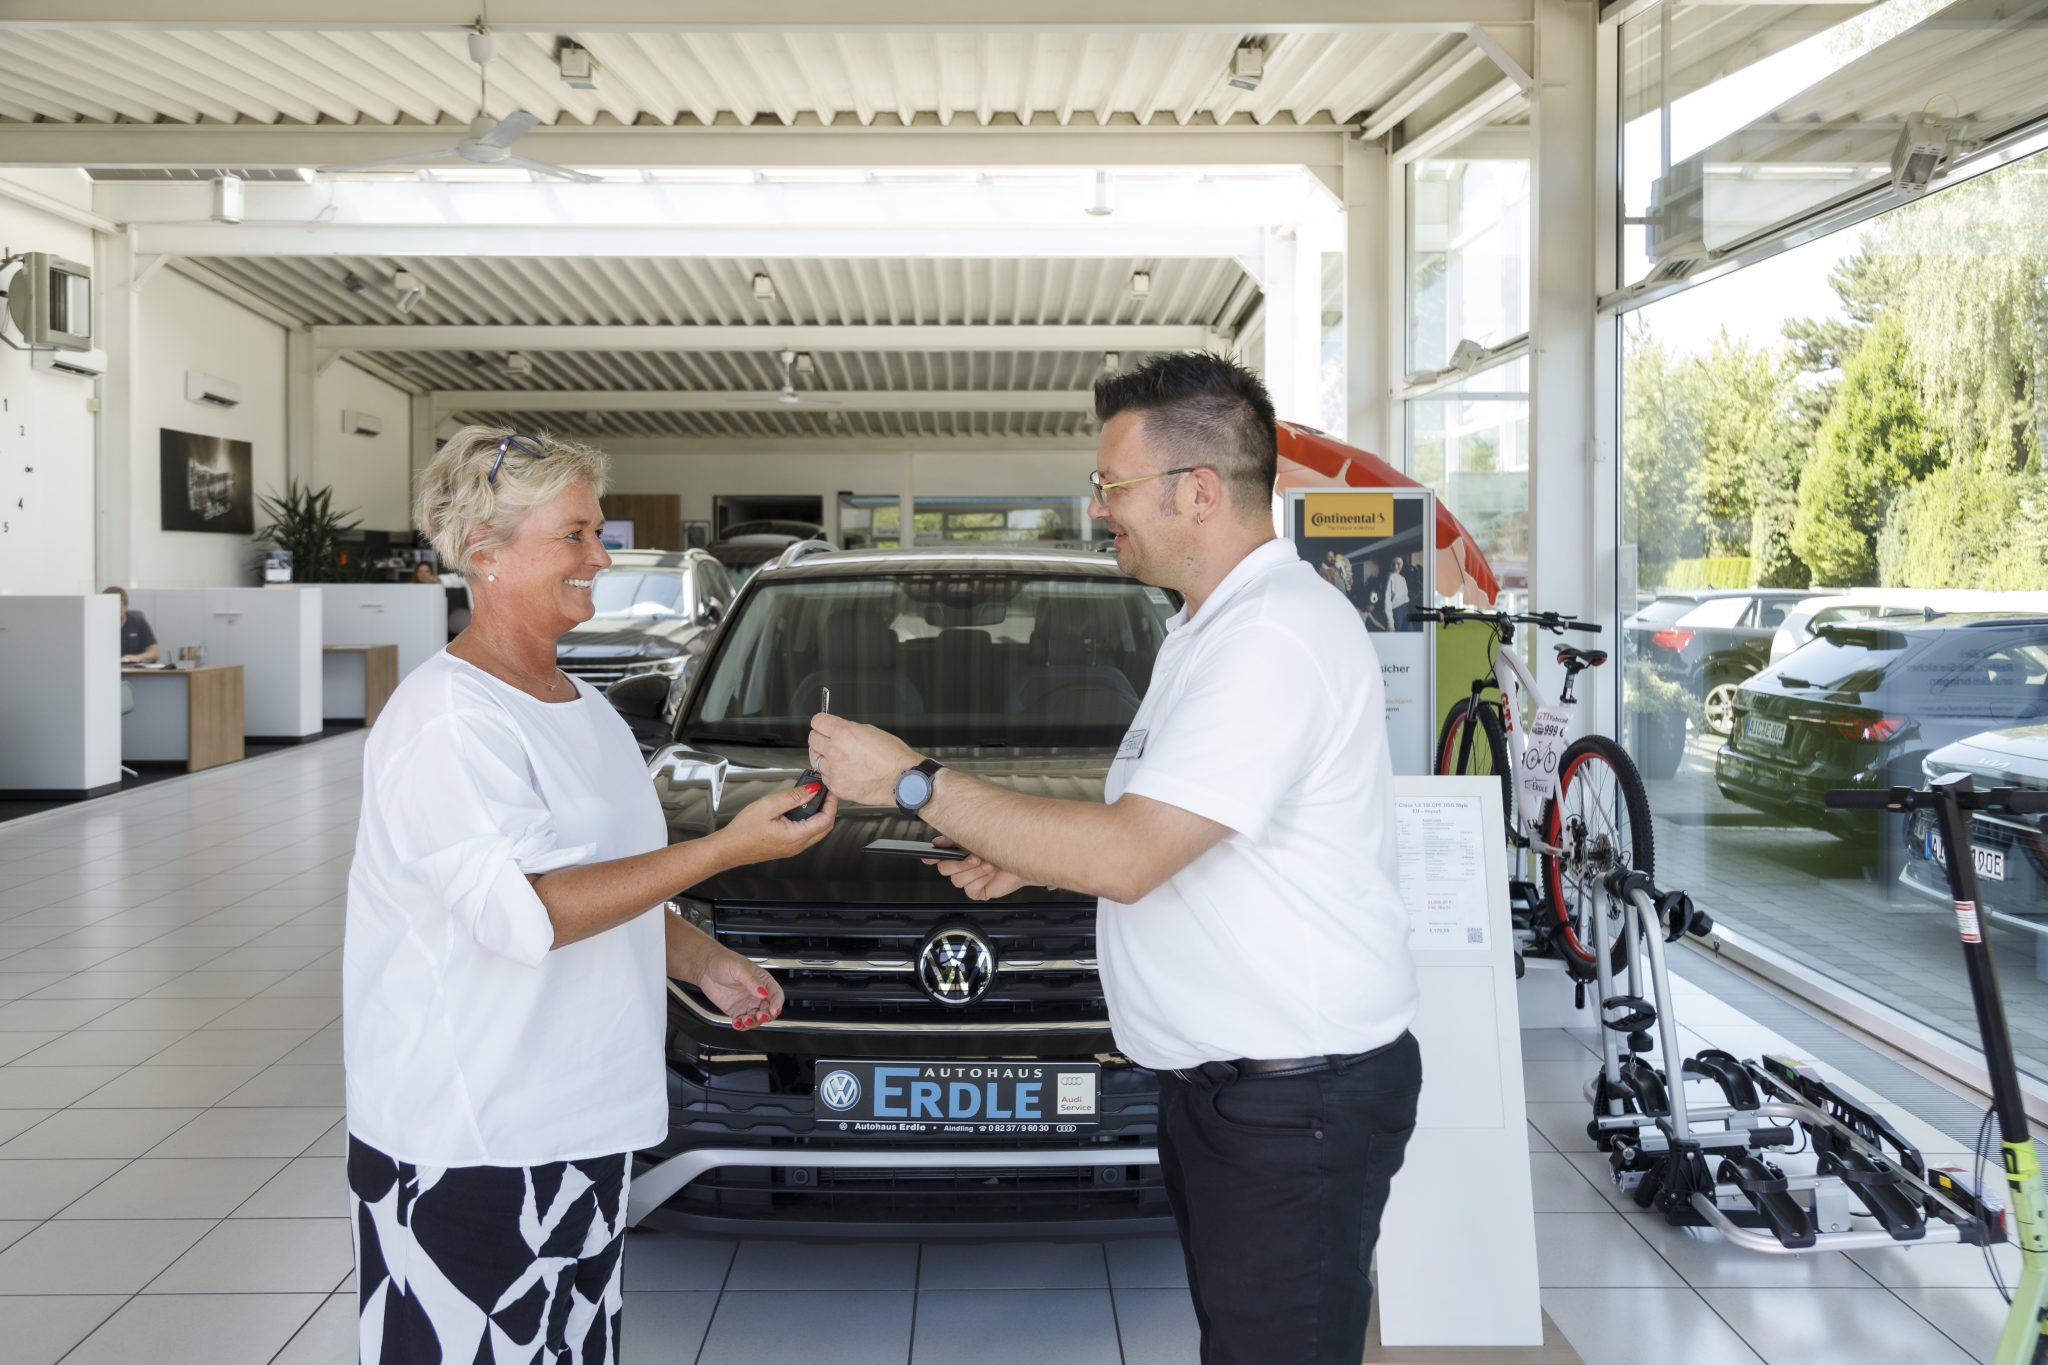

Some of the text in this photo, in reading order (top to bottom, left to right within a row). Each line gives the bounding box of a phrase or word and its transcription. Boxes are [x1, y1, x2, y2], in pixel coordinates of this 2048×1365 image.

[1311, 512, 1376, 527] Continental
[1543, 724, 1559, 737] 999
[1770, 724, 1785, 741] 801
[924, 1067, 1043, 1078] AUTOHAUS
[873, 1066, 1043, 1119] ERDLE
[854, 1122, 897, 1131] Autohaus
[899, 1123, 926, 1131] Erdle
[943, 1125, 974, 1133] Aindling
